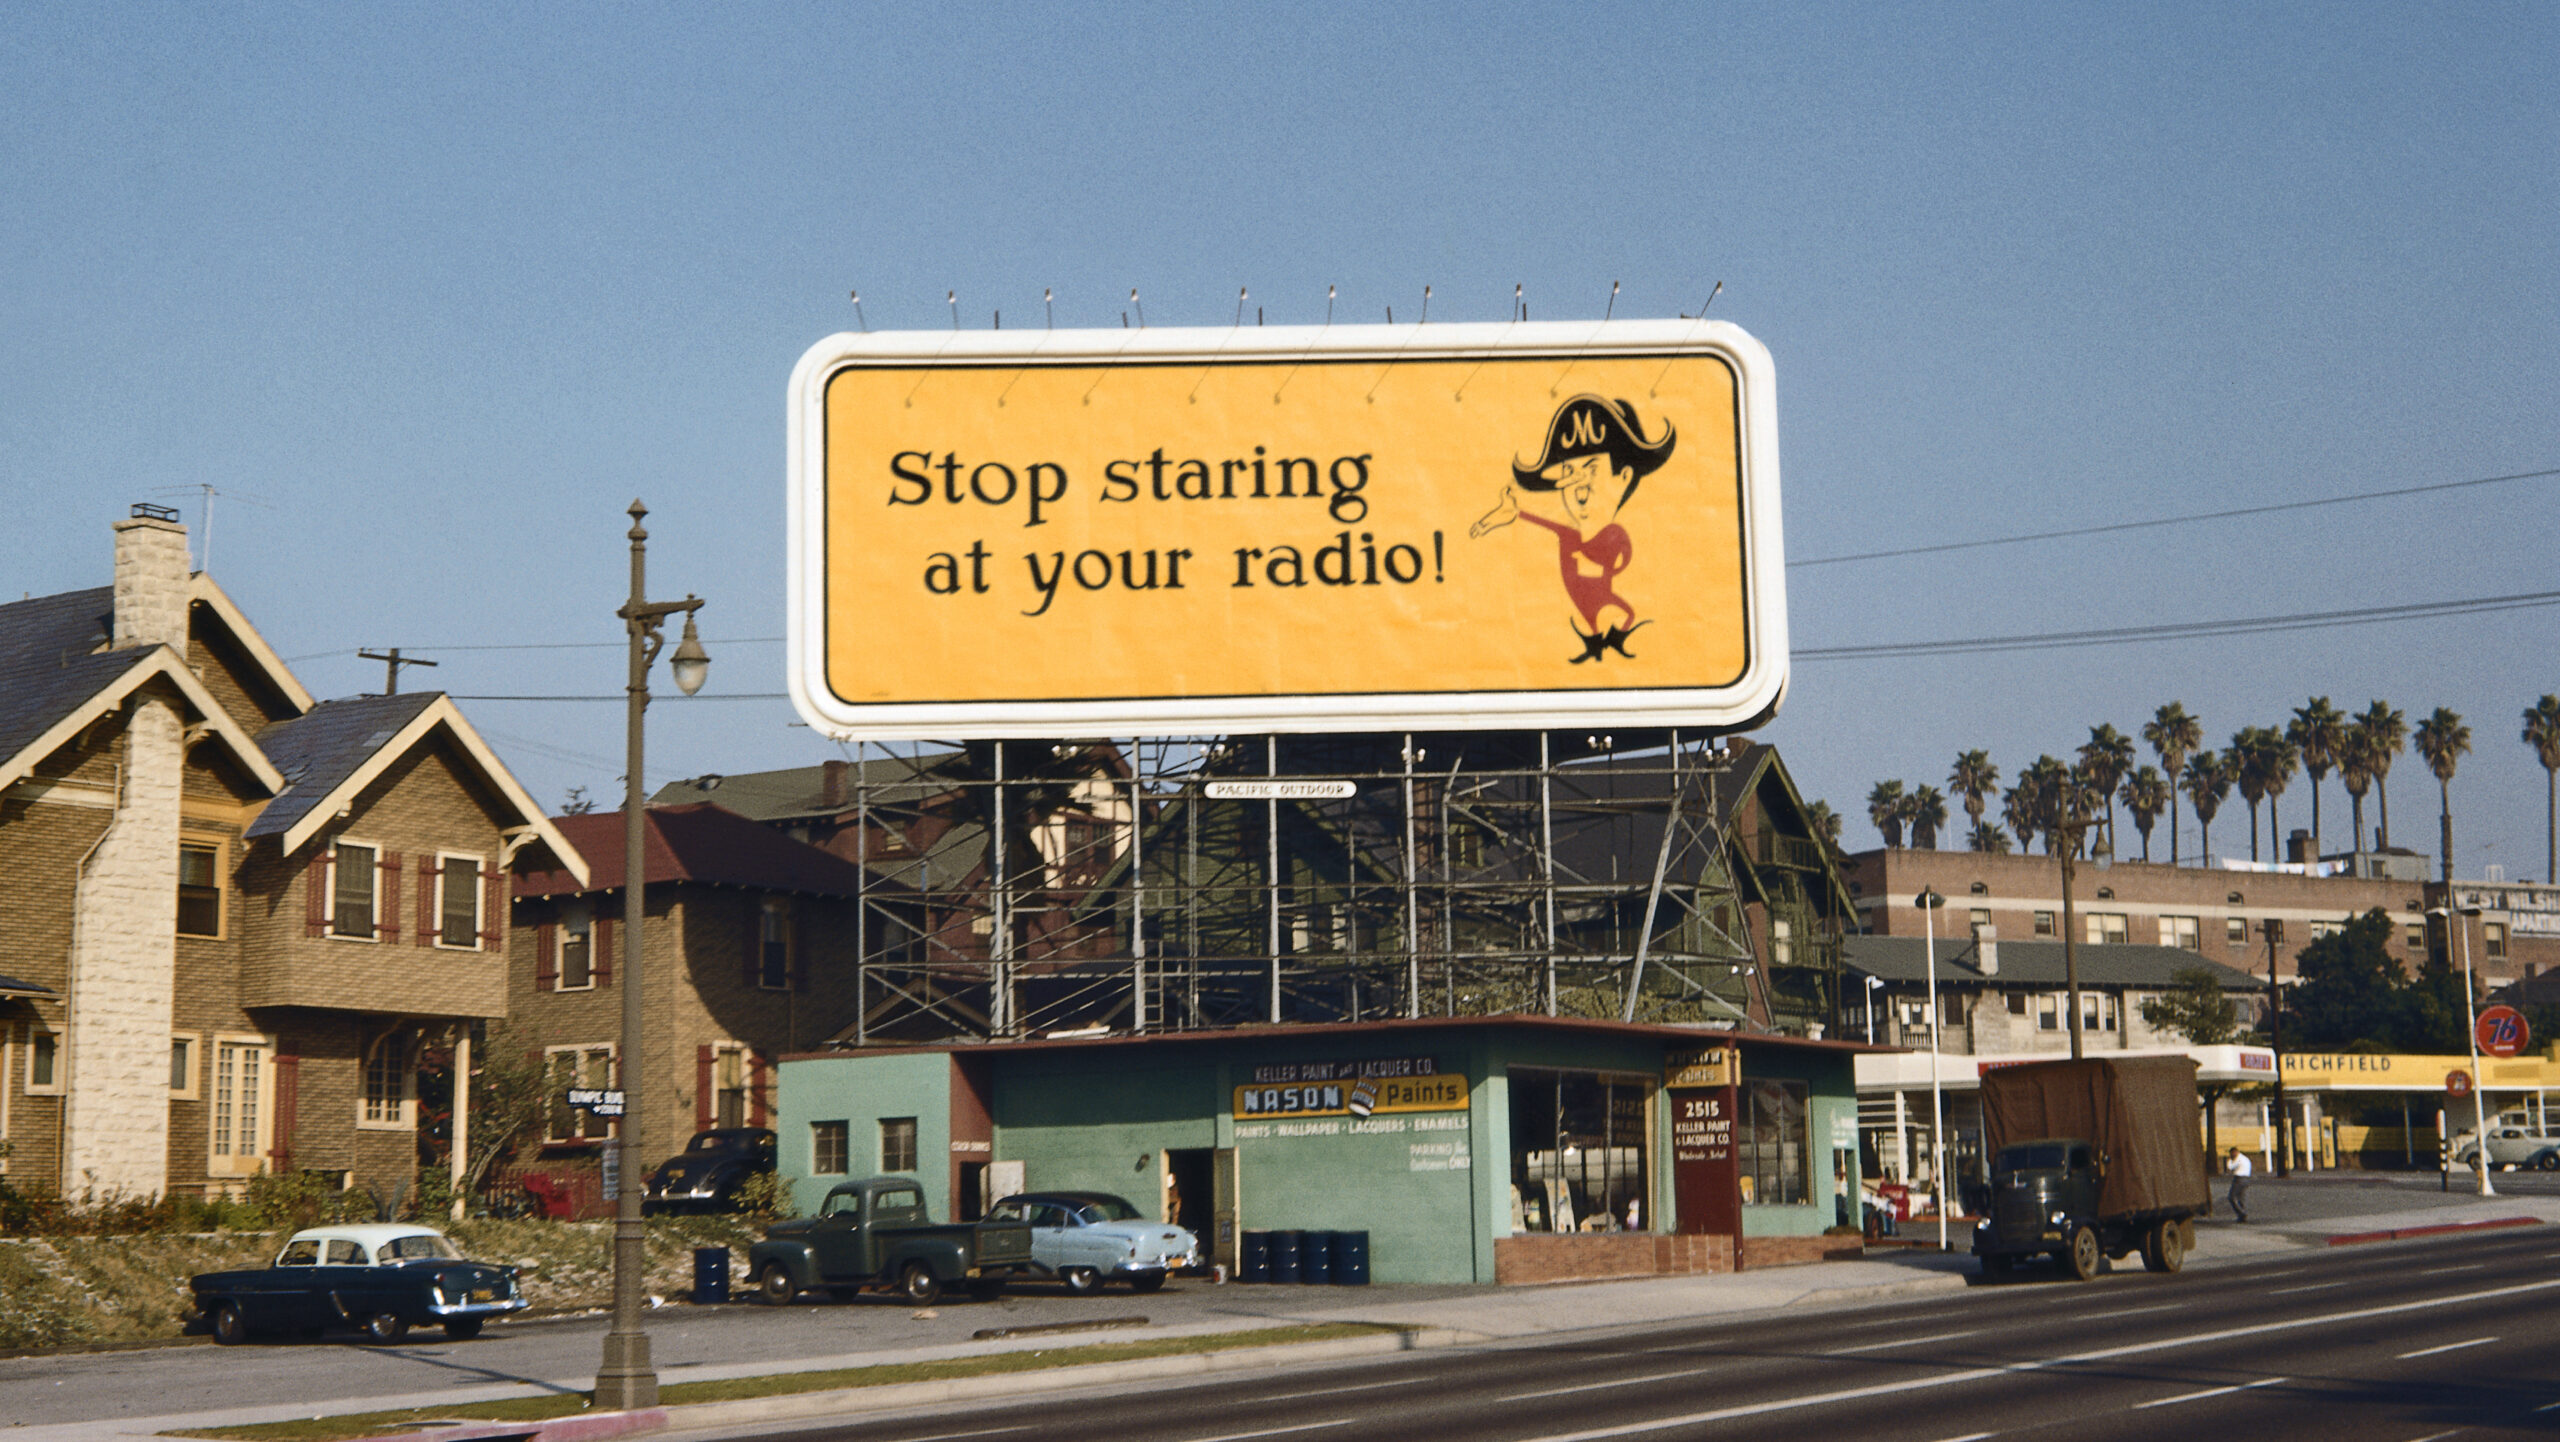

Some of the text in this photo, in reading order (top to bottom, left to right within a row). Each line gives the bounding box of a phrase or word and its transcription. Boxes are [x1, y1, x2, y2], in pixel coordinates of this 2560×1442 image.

[1561, 409, 1606, 448] M
[887, 445, 1372, 527] Stop staring
[924, 530, 1444, 616] at your radio!
[1216, 783, 1344, 795] PACIFIC OUTDOOR
[2488, 1014, 2518, 1045] 76
[1255, 1065, 1297, 1082] KELLER
[1301, 1064, 1335, 1079] PAINT
[1358, 1059, 1411, 1078] LACQUER
[2286, 1056, 2391, 1070] RICHFIELD
[1244, 1086, 1340, 1112] NASON
[1387, 1082, 1457, 1106] Paints
[1685, 1100, 1719, 1118] 2515
[1235, 1116, 1469, 1138] PAINTS WALLPAPER LACQUERS ENAMELS
[1676, 1119, 1731, 1134] KELLER PAINT
[1410, 1143, 1452, 1155] PARKING
[1682, 1133, 1716, 1146] LACQUER
